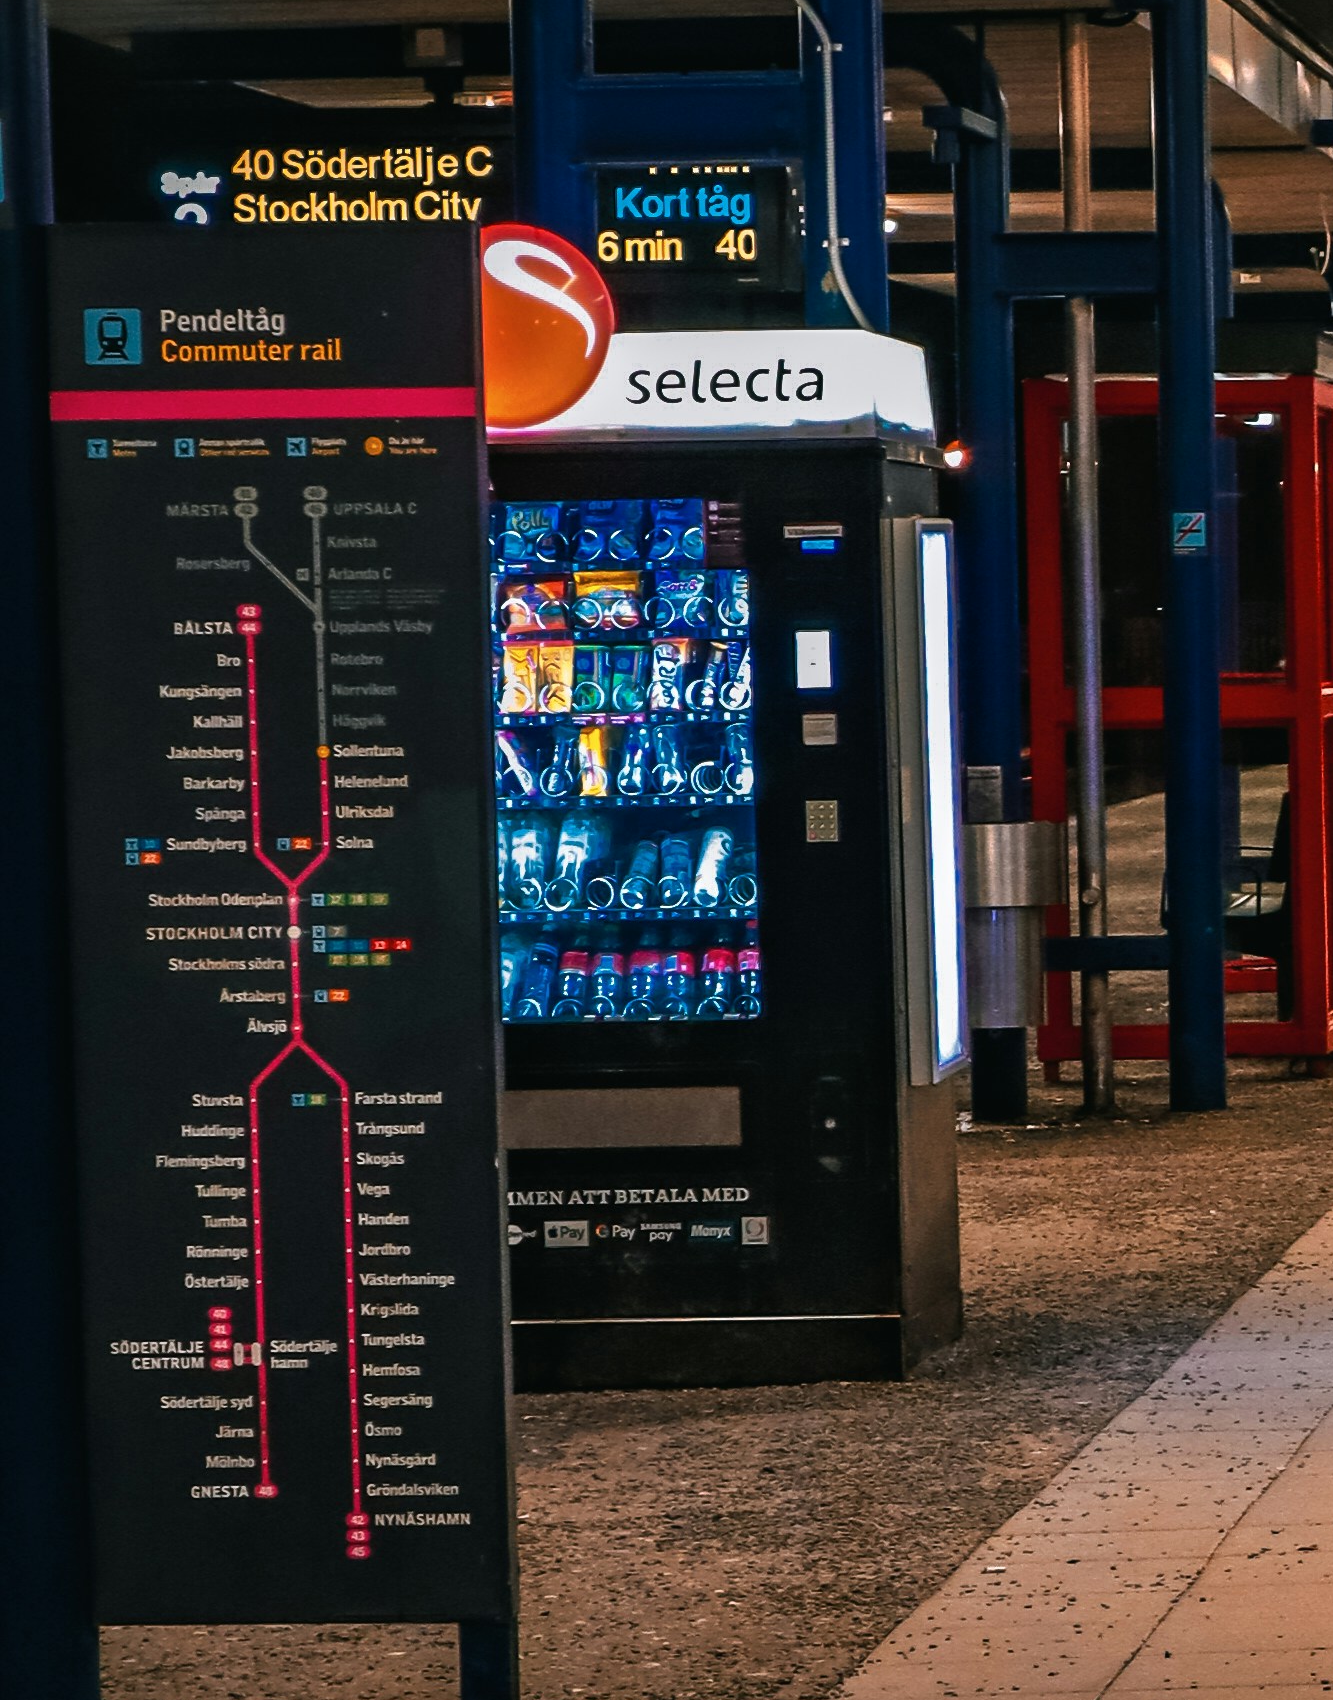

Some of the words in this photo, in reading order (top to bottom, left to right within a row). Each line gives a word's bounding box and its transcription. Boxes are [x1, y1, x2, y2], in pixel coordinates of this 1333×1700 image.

[233, 150, 274, 178] 40
[282, 147, 458, 185] Södertälje
[464, 147, 493, 177] C
[234, 192, 408, 223] Stockholm
[413, 193, 481, 222] City
[616, 186, 689, 219] Kort
[696, 186, 752, 224] tåg
[625, 231, 683, 260] min
[716, 230, 756, 260] 40
[160, 308, 286, 335] Pendeltåg
[161, 340, 294, 362] Commuter
[300, 338, 341, 361] rail
[626, 360, 825, 403] selecta
[333, 503, 403, 515] UPPSALA
[407, 502, 417, 514] C
[382, 567, 392, 580] C
[242, 606, 256, 616] 43
[174, 620, 233, 635] BÅLSTA
[217, 654, 241, 667] Bro
[159, 685, 242, 700] Kungsängen
[193, 716, 242, 728] Kallhäll
[166, 746, 243, 760] Jakobsberg
[334, 745, 404, 757] Sollentuna
[183, 777, 245, 791] Barkarby
[334, 775, 408, 787] Helenelund
[195, 807, 246, 822] Spånga
[335, 806, 394, 818] Ulriksdal
[167, 838, 247, 852] Sundbyberg
[336, 837, 374, 849] Solna
[149, 894, 218, 906] Stockholm
[221, 893, 283, 908] Odenplan
[147, 927, 243, 940] STOCKHOLM
[248, 926, 282, 938] CITY
[169, 958, 246, 971] Stockholms
[249, 958, 285, 970] södra
[220, 988, 286, 1004] Årstaberg
[247, 1019, 287, 1035] Älvsjö
[192, 1094, 244, 1107] Stuvsta
[355, 1092, 398, 1104] Farsta
[400, 1092, 442, 1104] strand
[181, 1124, 244, 1139] Huddinge
[356, 1121, 425, 1136] Trångsund
[156, 1155, 245, 1170] Flemingsberg
[357, 1152, 404, 1167] Skogås
[195, 1185, 246, 1199] Tullinge
[357, 1184, 390, 1197] Vega
[568, 1189, 611, 1205] ATT
[615, 1188, 698, 1204] BETALA
[702, 1187, 750, 1203] MED
[202, 1215, 247, 1228] Tumba
[358, 1213, 409, 1226] Handen
[560, 1226, 585, 1240] Pay
[612, 1225, 636, 1240] Pay
[649, 1230, 673, 1242] pay
[186, 1245, 248, 1260] Rönninge
[359, 1244, 410, 1256] Jordbro
[184, 1275, 249, 1290] Östertälje
[360, 1273, 455, 1287] Västerhaninge
[361, 1303, 419, 1318] Krigslida
[111, 1341, 204, 1355] SÖDERTÄLJE
[270, 1340, 337, 1354] Södertälje
[362, 1334, 424, 1348] Tungelsta
[132, 1357, 204, 1370] CENTRUM
[271, 1357, 308, 1368] hamn
[362, 1364, 420, 1377] Hemfosa
[160, 1395, 229, 1410] Södertälje
[231, 1395, 253, 1410] syd
[363, 1394, 432, 1408] Segersäng
[216, 1426, 254, 1438] Järna
[365, 1423, 402, 1436] Ösmo
[206, 1456, 255, 1469] Mölnbo
[365, 1453, 436, 1468] Nynäsgård
[191, 1485, 249, 1498] GNESTA
[367, 1483, 459, 1496] Gröndalsviken
[375, 1513, 470, 1526] NYNÄSHAMN
